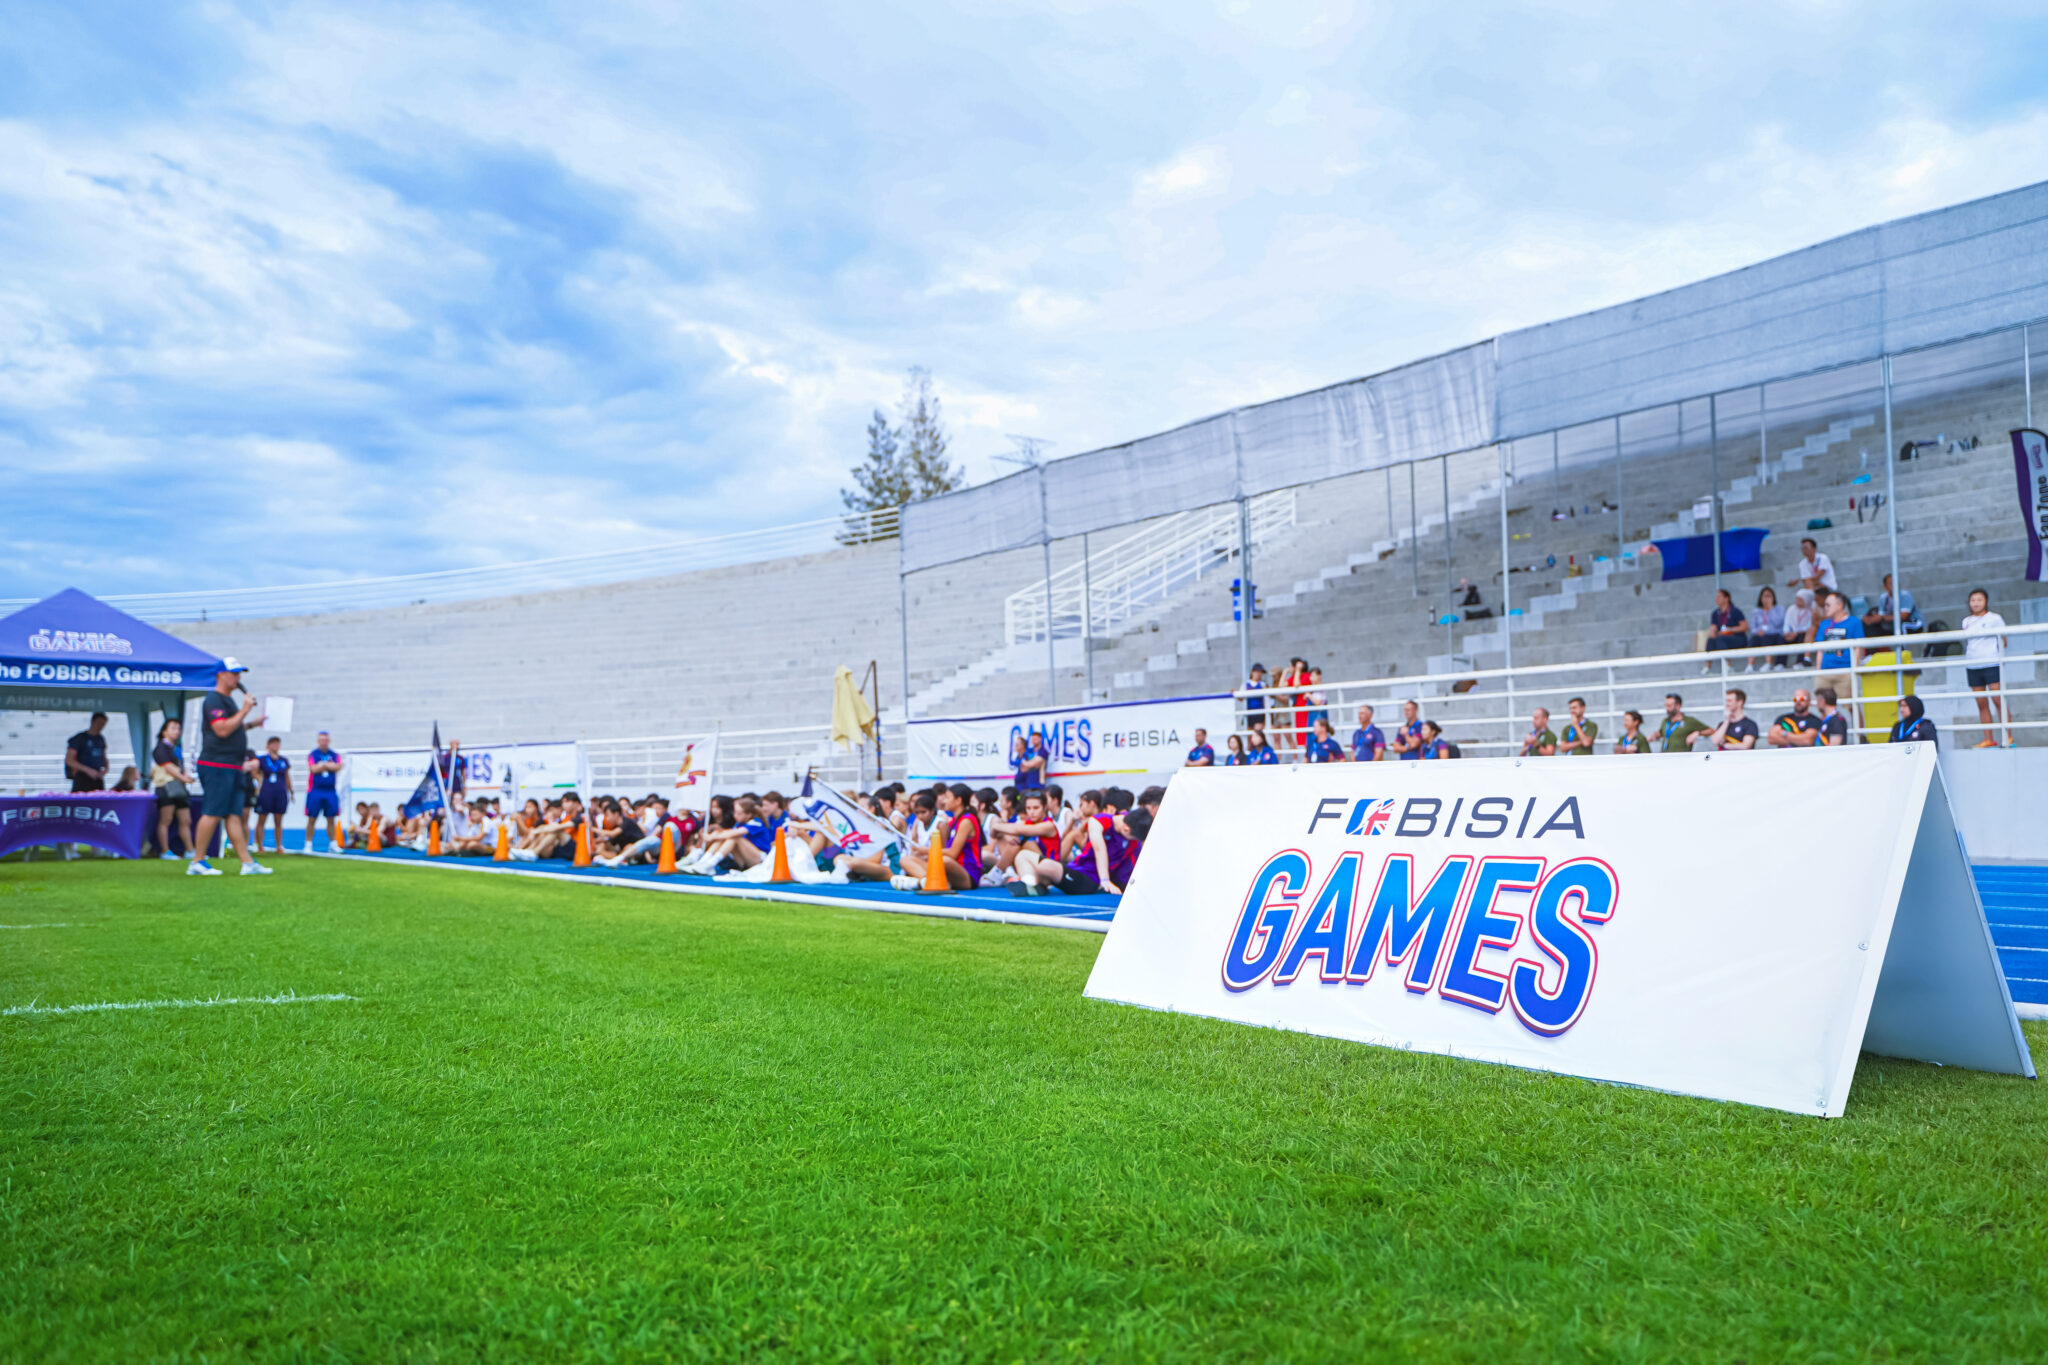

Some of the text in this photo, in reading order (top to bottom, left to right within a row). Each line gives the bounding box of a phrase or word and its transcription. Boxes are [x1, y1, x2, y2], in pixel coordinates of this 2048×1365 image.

[28, 633, 133, 656] GAMES
[0, 661, 183, 684] he FOBISIA Games
[940, 742, 999, 758] FOBISIA
[1103, 730, 1181, 748] FOBISIA
[2, 806, 121, 826] FOBISIA
[1308, 796, 1585, 839] FOBISIA
[1222, 848, 1619, 1037] GAMES
